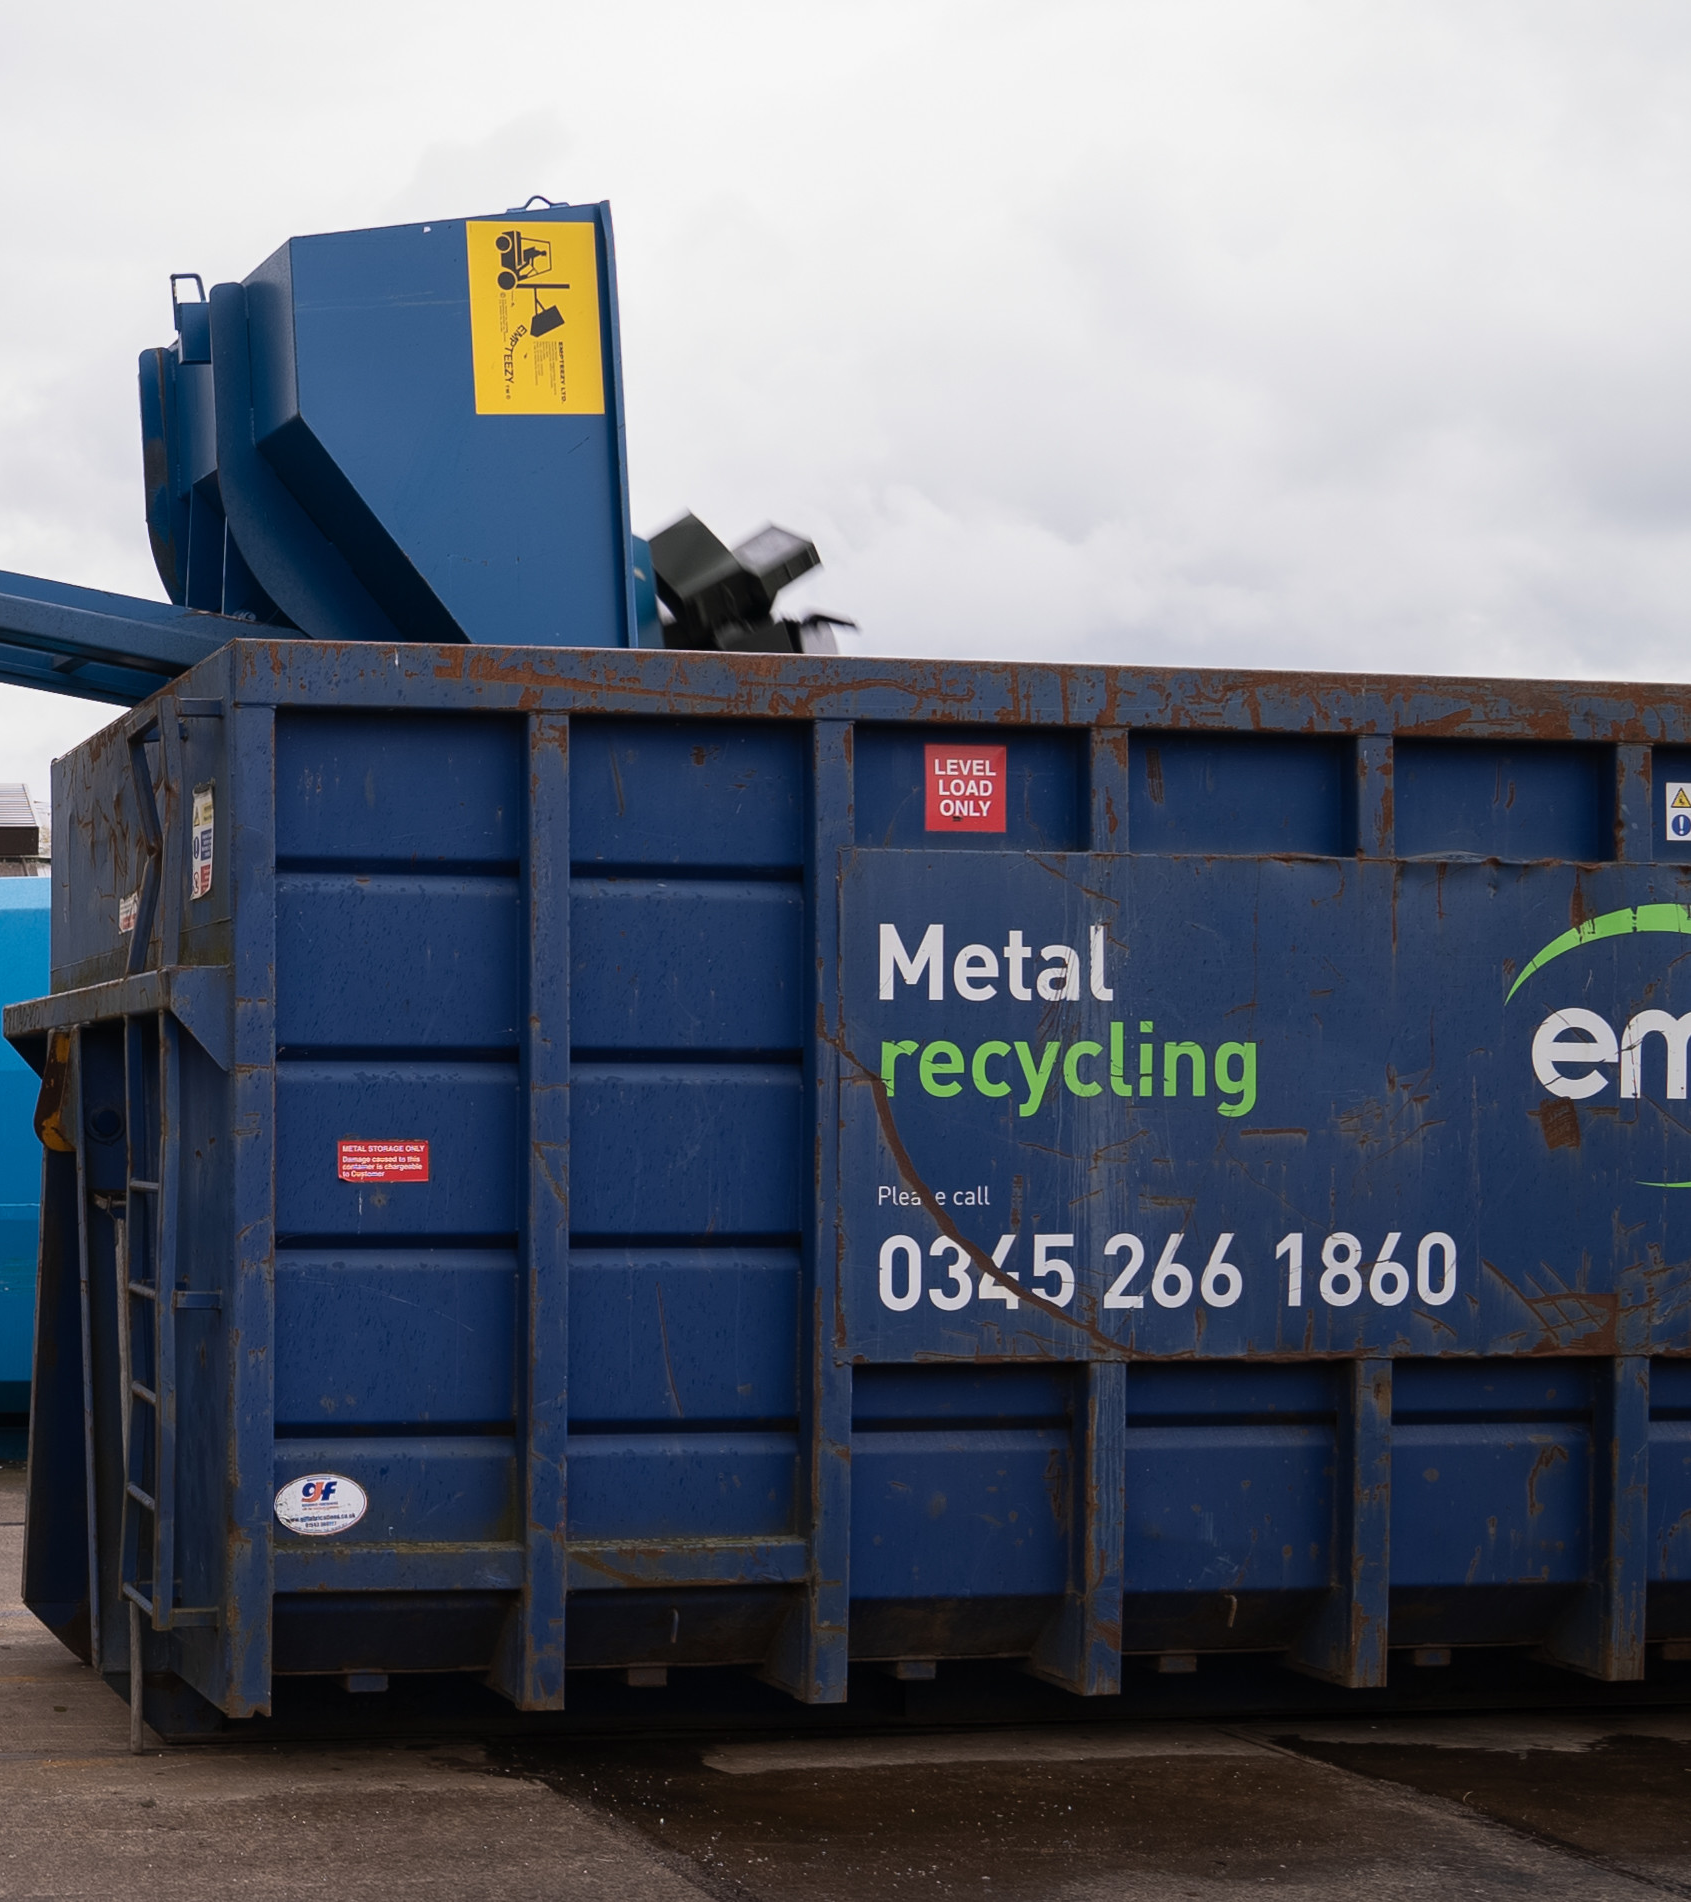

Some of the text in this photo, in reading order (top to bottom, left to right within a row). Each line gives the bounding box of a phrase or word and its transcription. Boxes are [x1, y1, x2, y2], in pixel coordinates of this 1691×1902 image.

[503, 324, 528, 384] EMPTEEZY
[558, 341, 566, 385] EMPTEEZY
[934, 758, 997, 776] LEVEL
[938, 779, 993, 796] LOAD
[939, 799, 992, 817] ONLY
[879, 923, 1114, 1001] Metal
[880, 1020, 1257, 1118] recycling
[342, 1145, 425, 1153] METAL STORAGE ONLY
[342, 1156, 370, 1165] Damage
[407, 1155, 421, 1163] this
[878, 1185, 991, 1207] Pleae call
[878, 1231, 1457, 1312] 0345 266 1860
